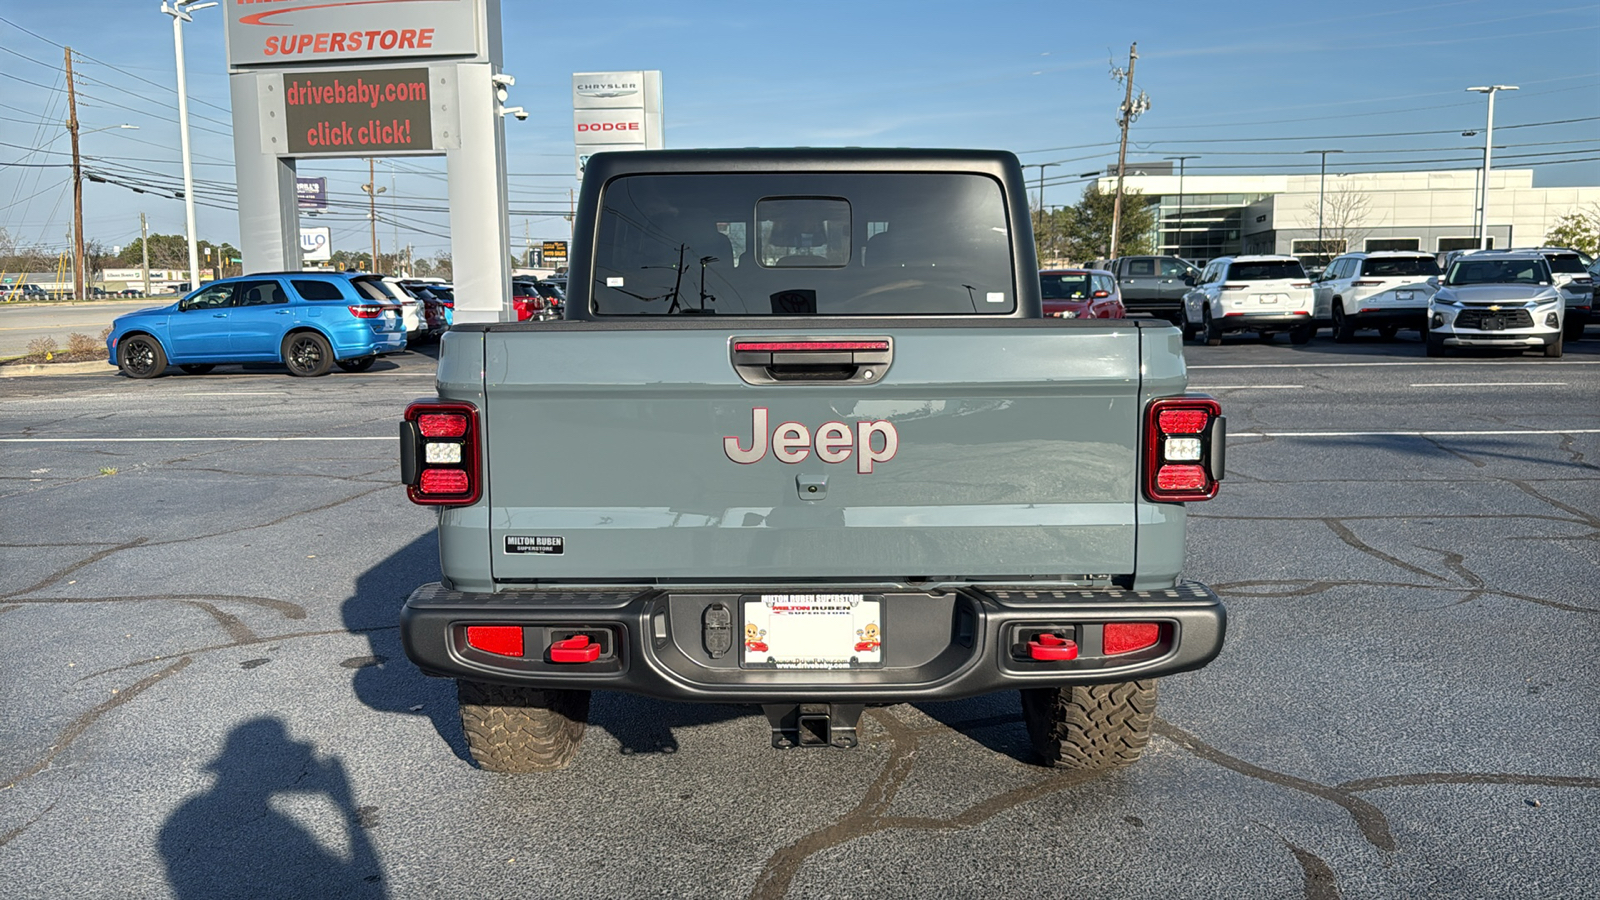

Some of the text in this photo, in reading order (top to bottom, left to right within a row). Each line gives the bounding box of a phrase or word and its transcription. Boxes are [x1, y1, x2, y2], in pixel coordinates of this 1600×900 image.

[263, 28, 435, 56] SUPERSTORE
[287, 78, 427, 108] drivebaby.com
[307, 119, 412, 146] click click!
[577, 122, 639, 132] DODGE
[301, 234, 326, 245] ILO
[723, 407, 899, 475] Jeep
[507, 536, 562, 546] MILTON RUBEN
[761, 594, 864, 602] MILTON RUBEN SUPERSTORE
